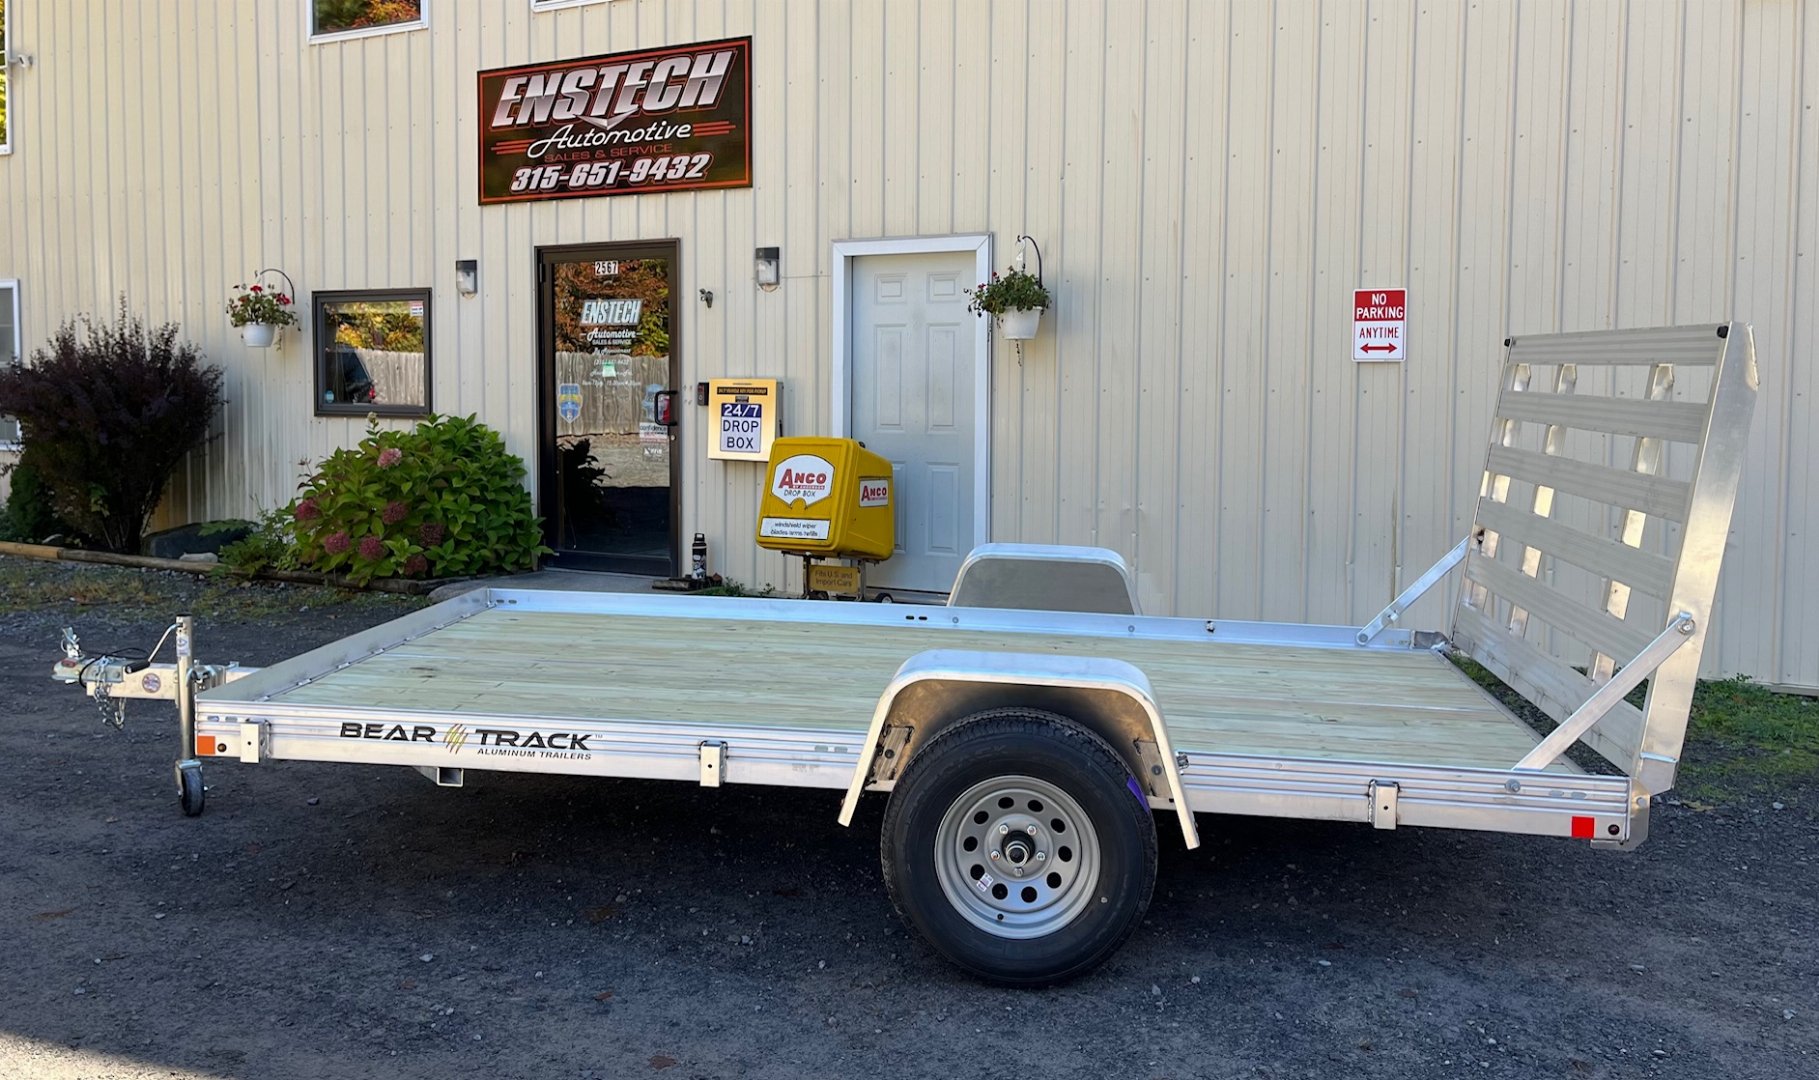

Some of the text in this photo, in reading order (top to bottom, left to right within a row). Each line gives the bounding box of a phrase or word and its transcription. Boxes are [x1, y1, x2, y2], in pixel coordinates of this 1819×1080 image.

[491, 50, 735, 128] ENSTECH
[527, 120, 692, 159] Automotive
[544, 143, 673, 163] SALES & SERVICE
[511, 153, 712, 192] 315-651-9432
[596, 261, 618, 275] 2567
[1371, 293, 1387, 305] NO
[580, 299, 642, 325] ENSTECH
[1356, 306, 1404, 320] PARKING
[586, 327, 637, 341] Automotive
[1359, 326, 1399, 339] ANYTIME
[723, 404, 759, 417] 24/7
[722, 419, 759, 433] DROP
[726, 436, 754, 449] BOX
[783, 489, 816, 498] DROP BOX
[340, 722, 437, 742] BEAR
[475, 728, 593, 751] TRACK
[477, 748, 592, 761] ALUMINUM TRAILERS
